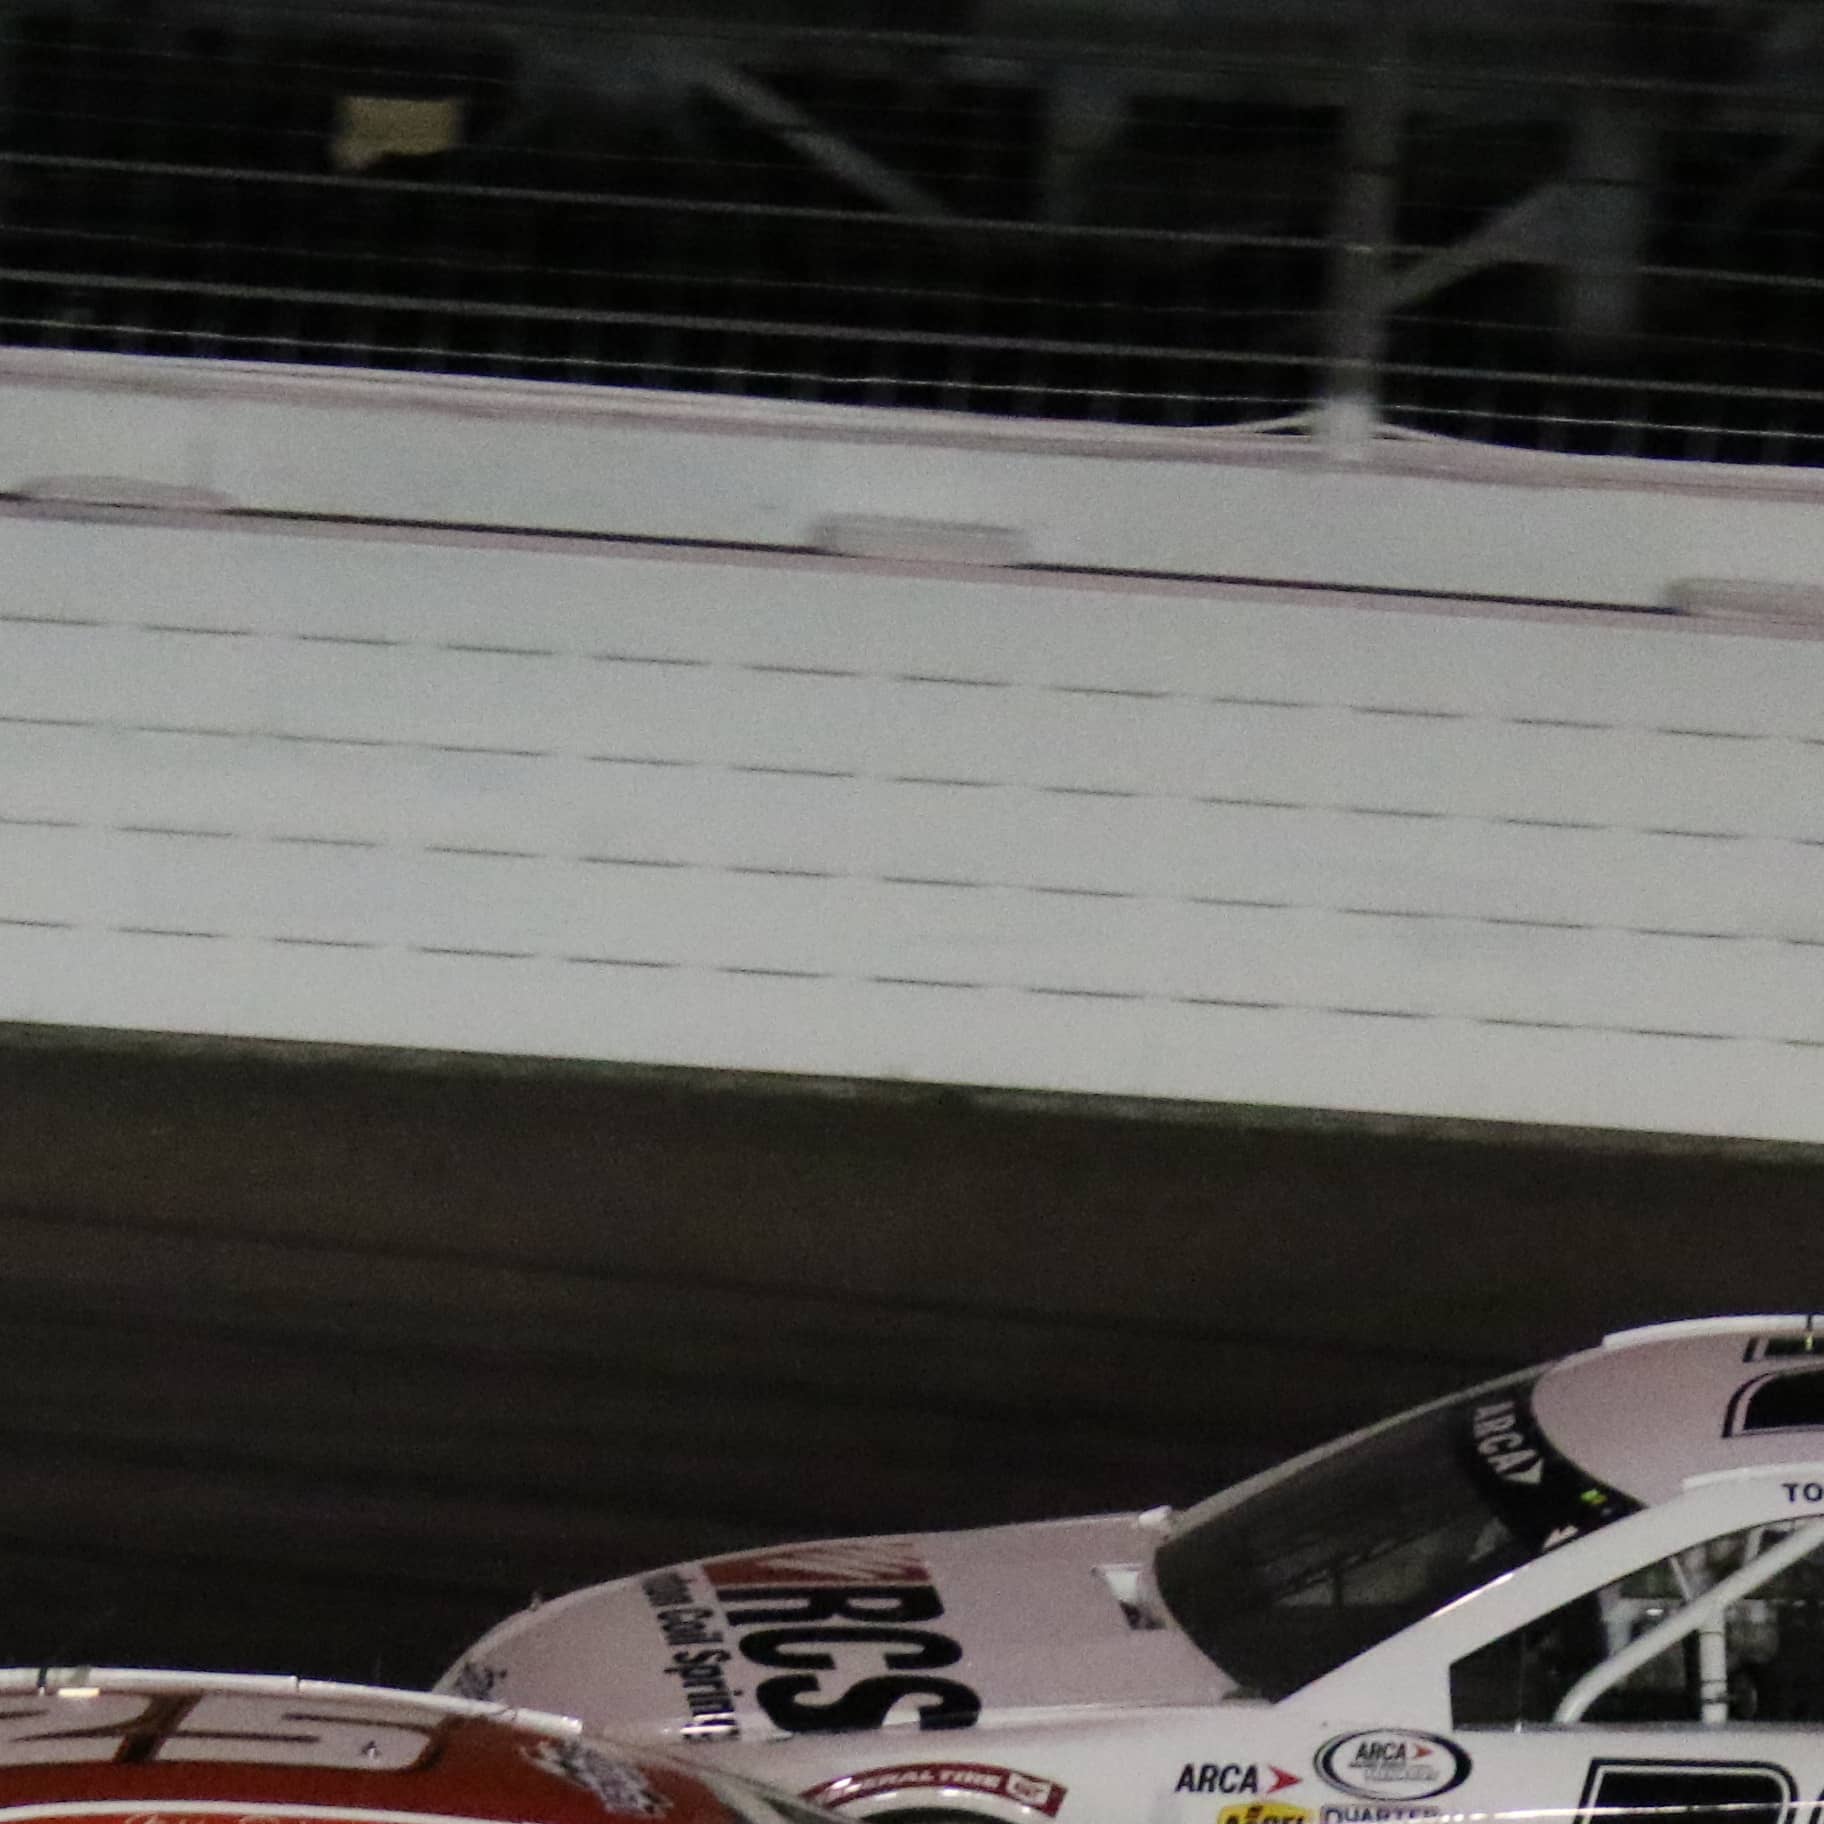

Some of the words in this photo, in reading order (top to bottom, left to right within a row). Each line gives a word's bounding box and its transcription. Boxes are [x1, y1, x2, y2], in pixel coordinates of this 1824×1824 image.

[714, 1585, 982, 1733] RCS
[1355, 1742, 1406, 1760] ARCA
[1174, 1763, 1259, 1794] ARCA
